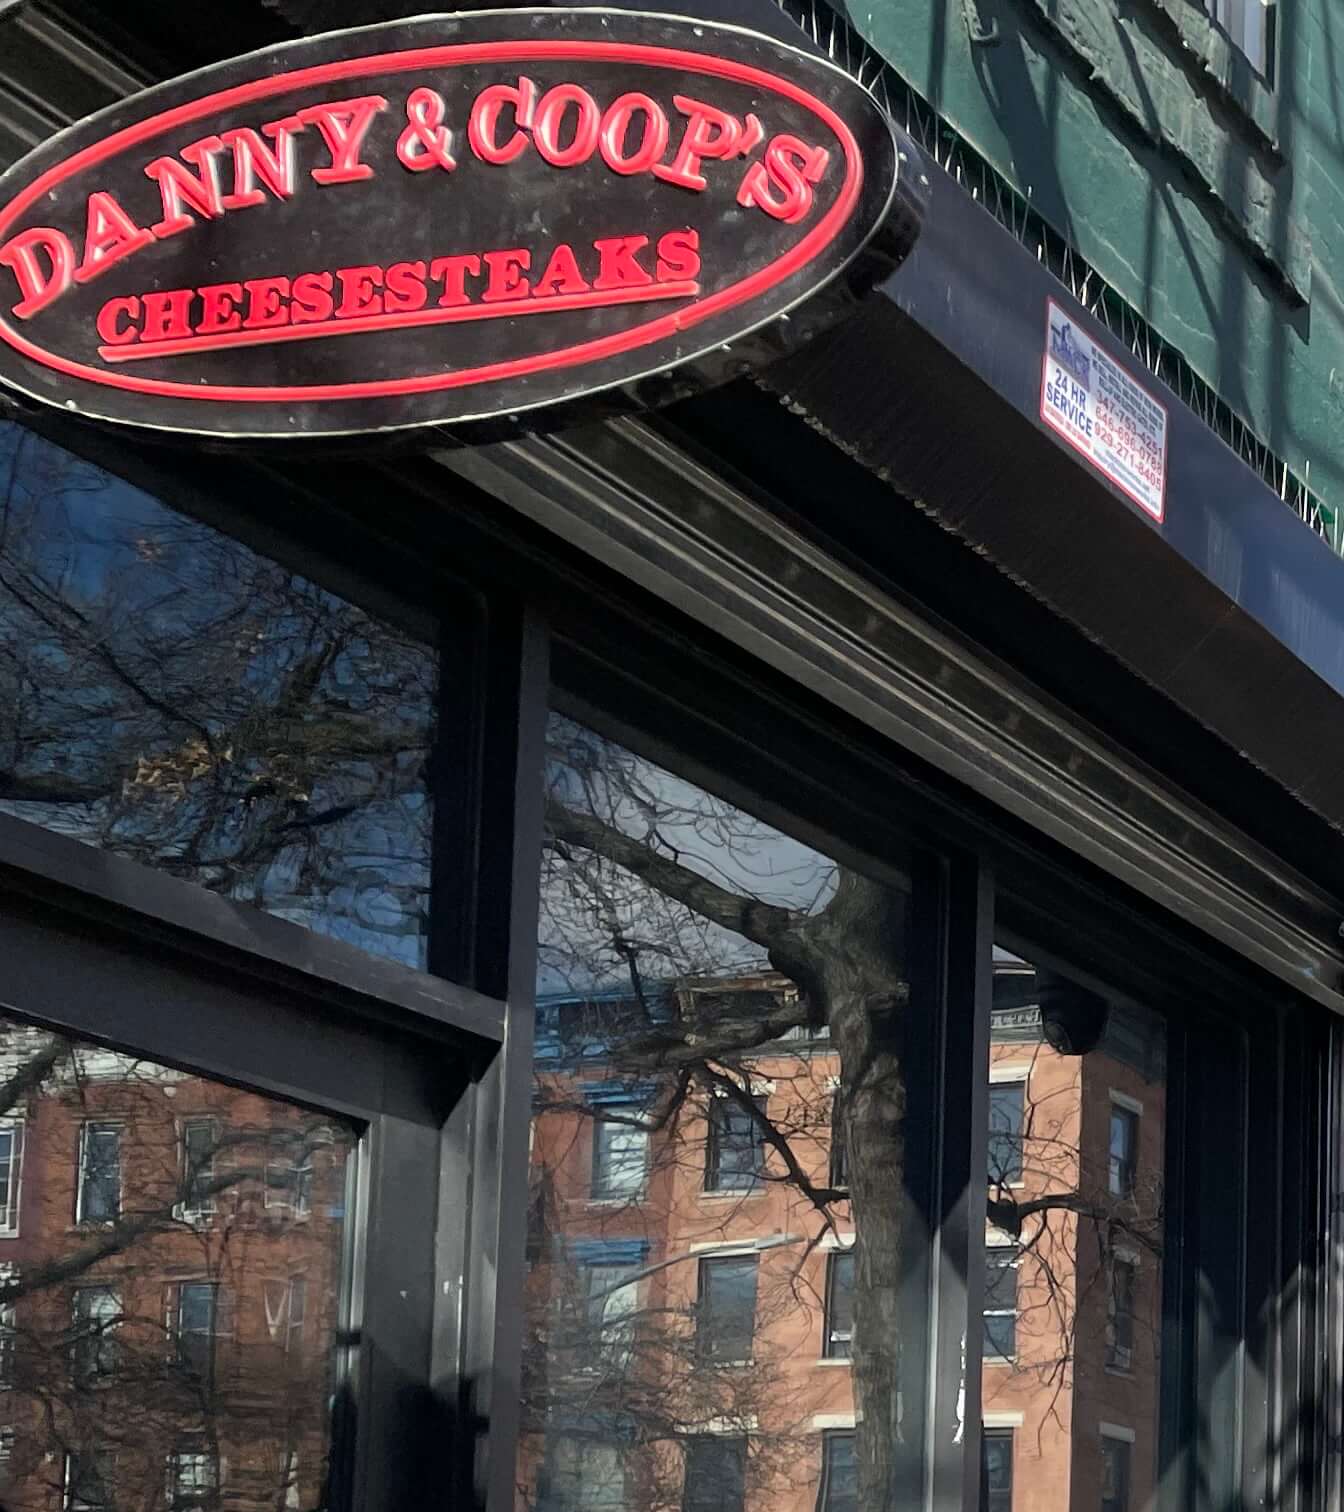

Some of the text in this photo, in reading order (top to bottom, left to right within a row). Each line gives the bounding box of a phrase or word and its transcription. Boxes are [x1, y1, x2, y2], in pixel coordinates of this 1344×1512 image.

[0, 76, 831, 320] DANNY & COOP'S
[96, 228, 702, 346] CHEESESTEAKS
[1046, 383, 1093, 438] SERVICE
[1055, 368, 1086, 410] 24 HR
